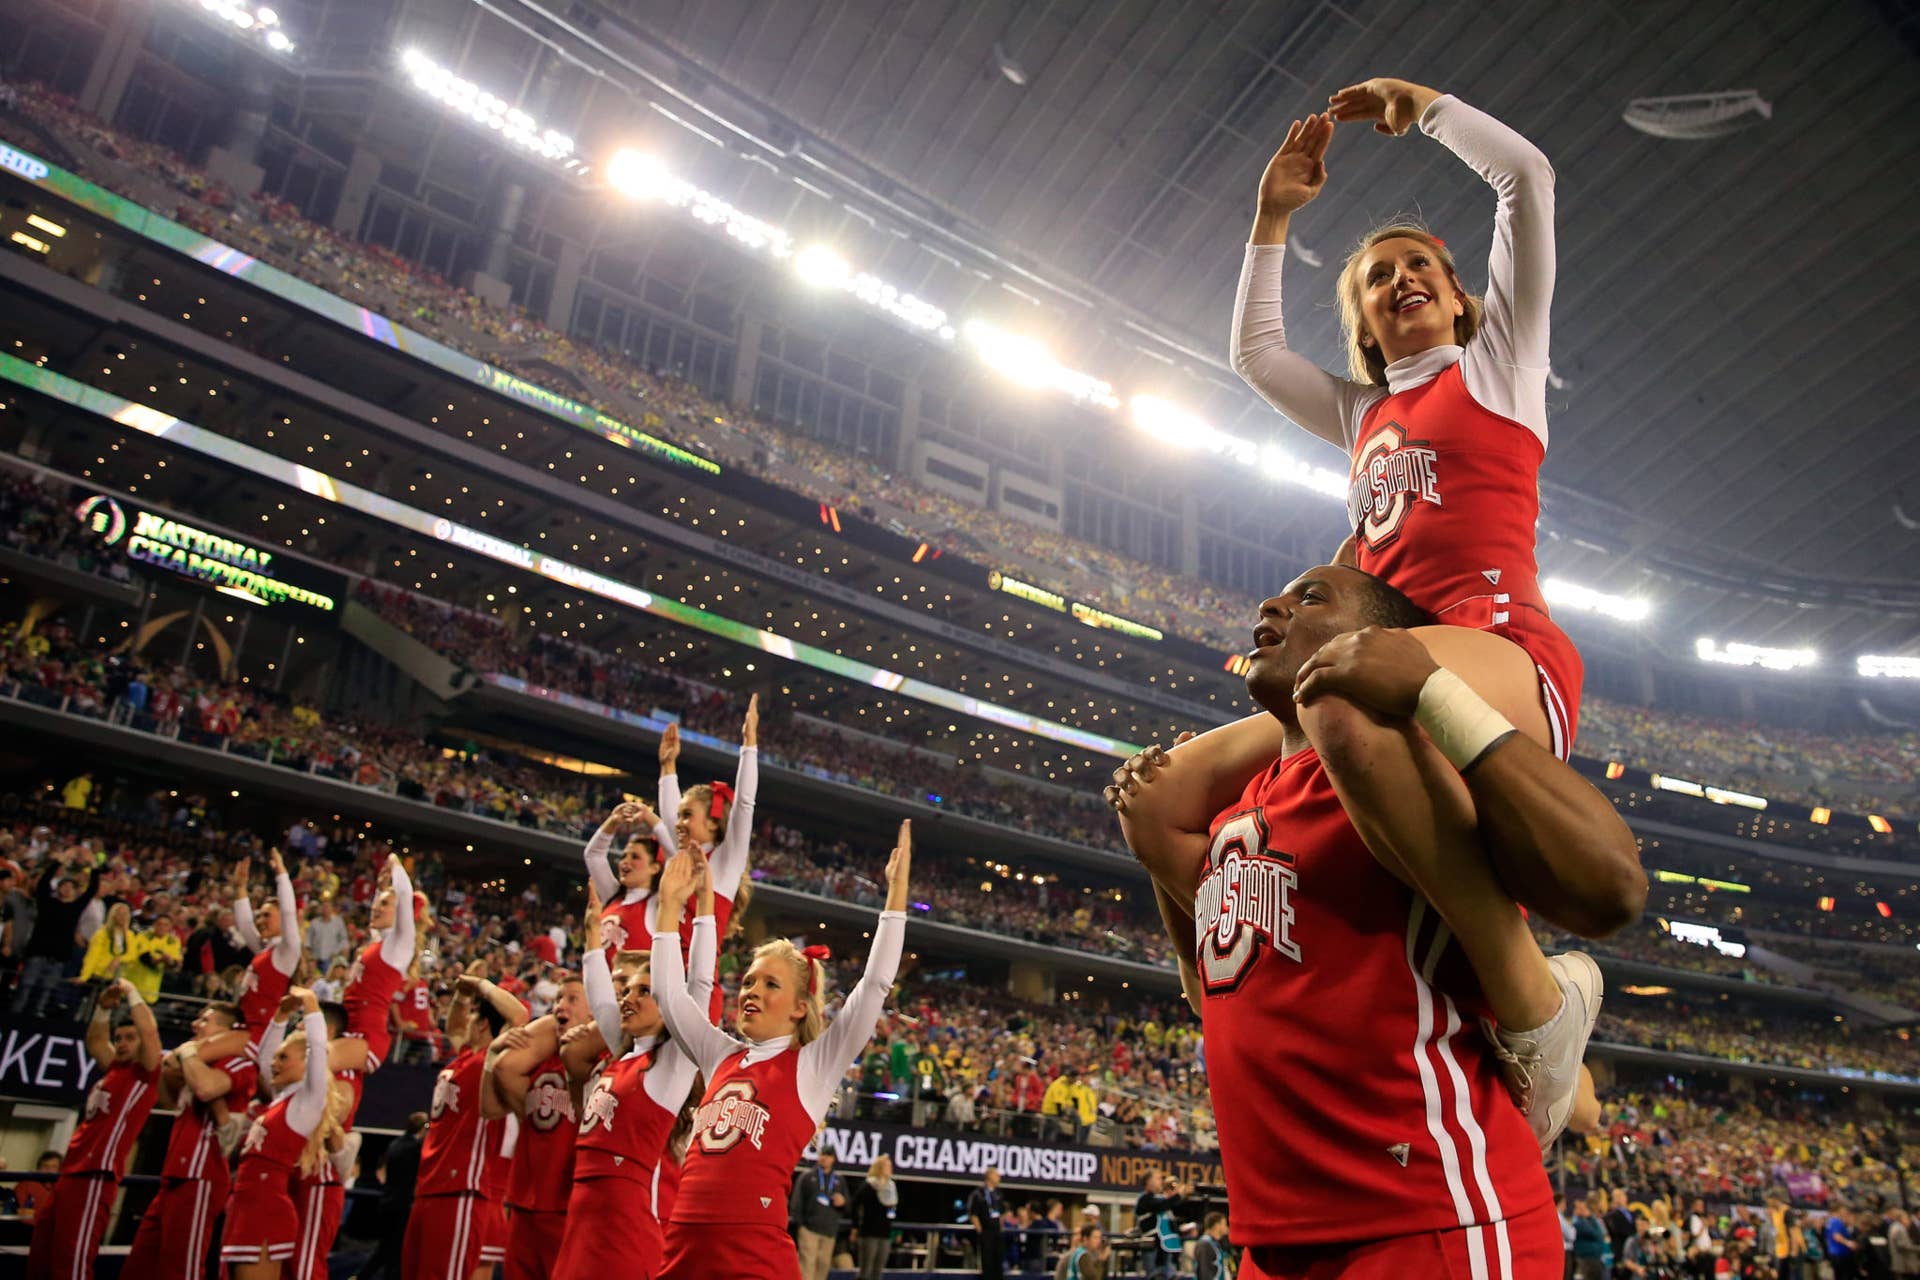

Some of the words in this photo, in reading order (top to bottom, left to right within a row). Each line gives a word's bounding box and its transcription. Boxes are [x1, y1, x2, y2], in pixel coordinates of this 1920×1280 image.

[1369, 447, 1442, 516] STATE
[133, 511, 274, 577] NATIONAL
[1217, 851, 1303, 963] STATE
[715, 1096, 771, 1151] STATE
[803, 1126, 882, 1165] NAL
[894, 1134, 1098, 1183] CHAMPIONSHIP
